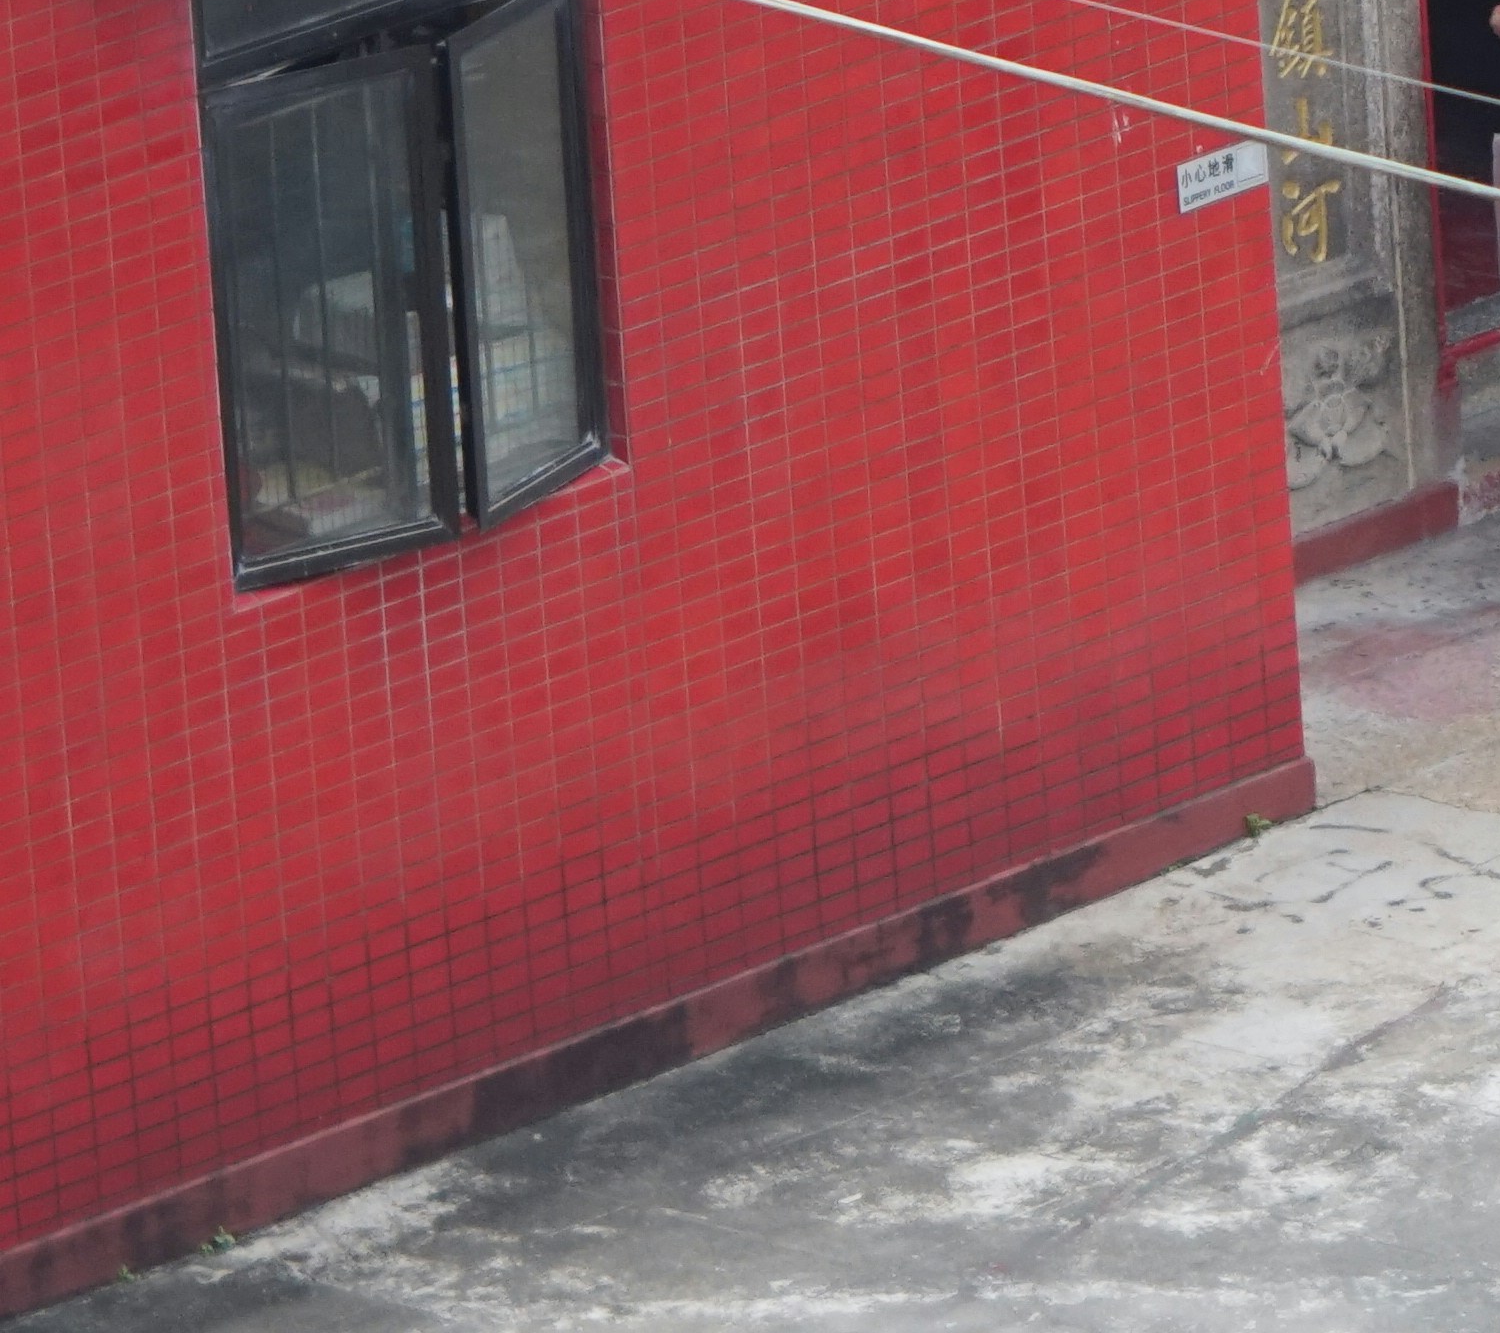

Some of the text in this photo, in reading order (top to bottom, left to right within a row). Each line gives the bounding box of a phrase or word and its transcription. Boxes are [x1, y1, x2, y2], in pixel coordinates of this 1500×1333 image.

[1180, 153, 1235, 189] 小心地滑
[1183, 180, 1236, 207] SLIPPERY FLOOR
